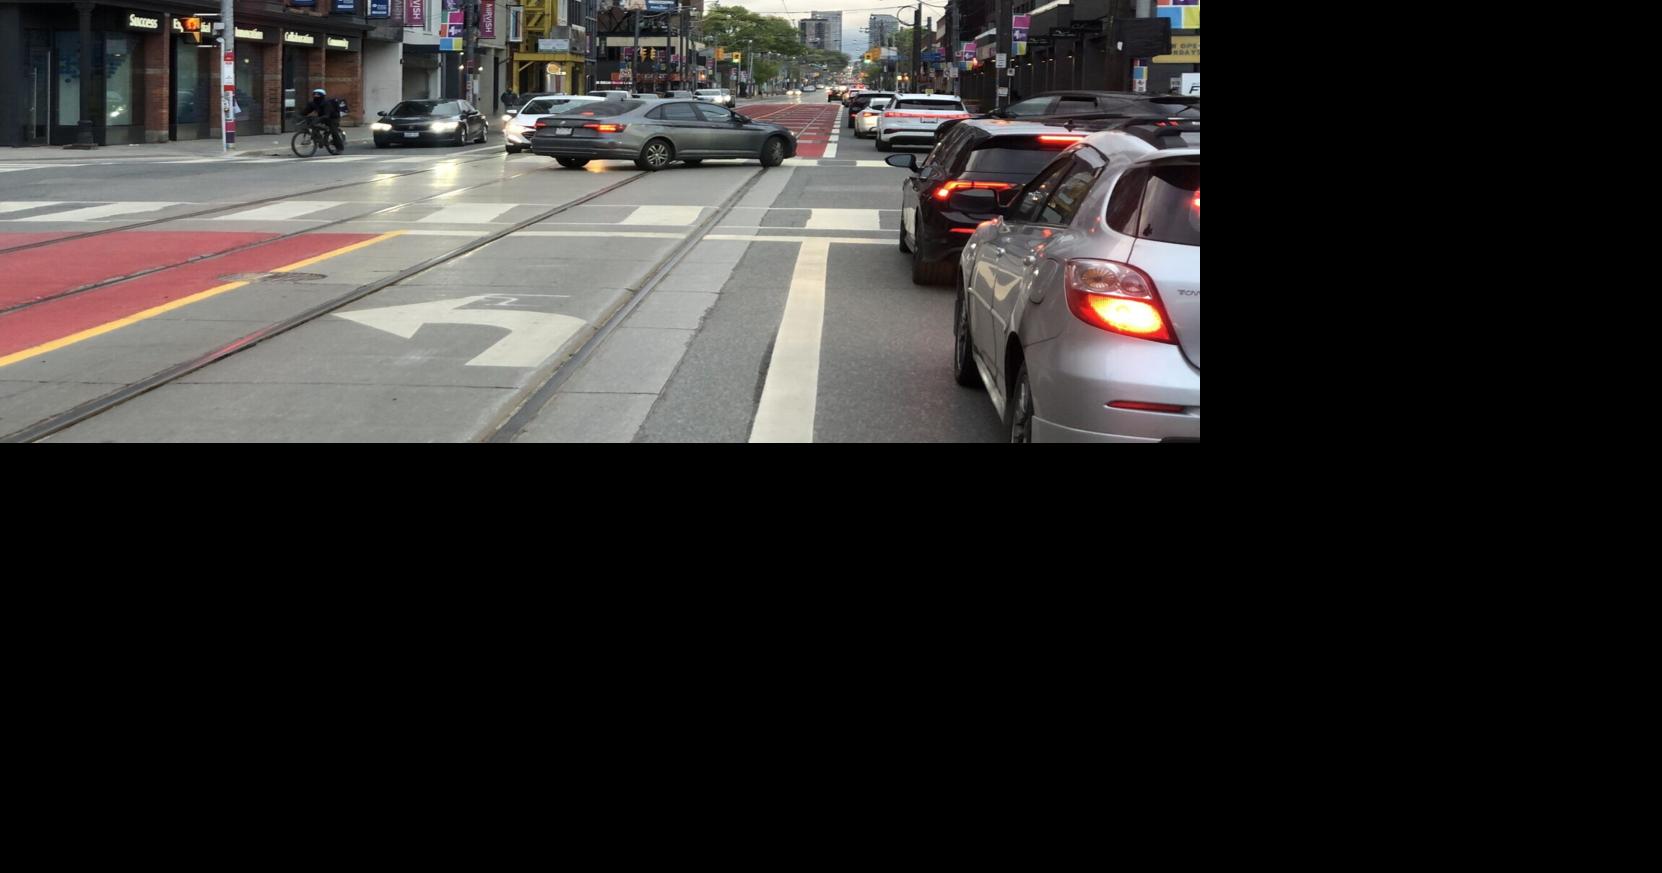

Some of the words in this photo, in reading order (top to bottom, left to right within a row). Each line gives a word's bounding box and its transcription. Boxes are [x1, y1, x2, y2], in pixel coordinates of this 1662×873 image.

[412, 0, 422, 19] VISH
[484, 3, 493, 33] MIRVISH
[129, 13, 158, 29] Success
